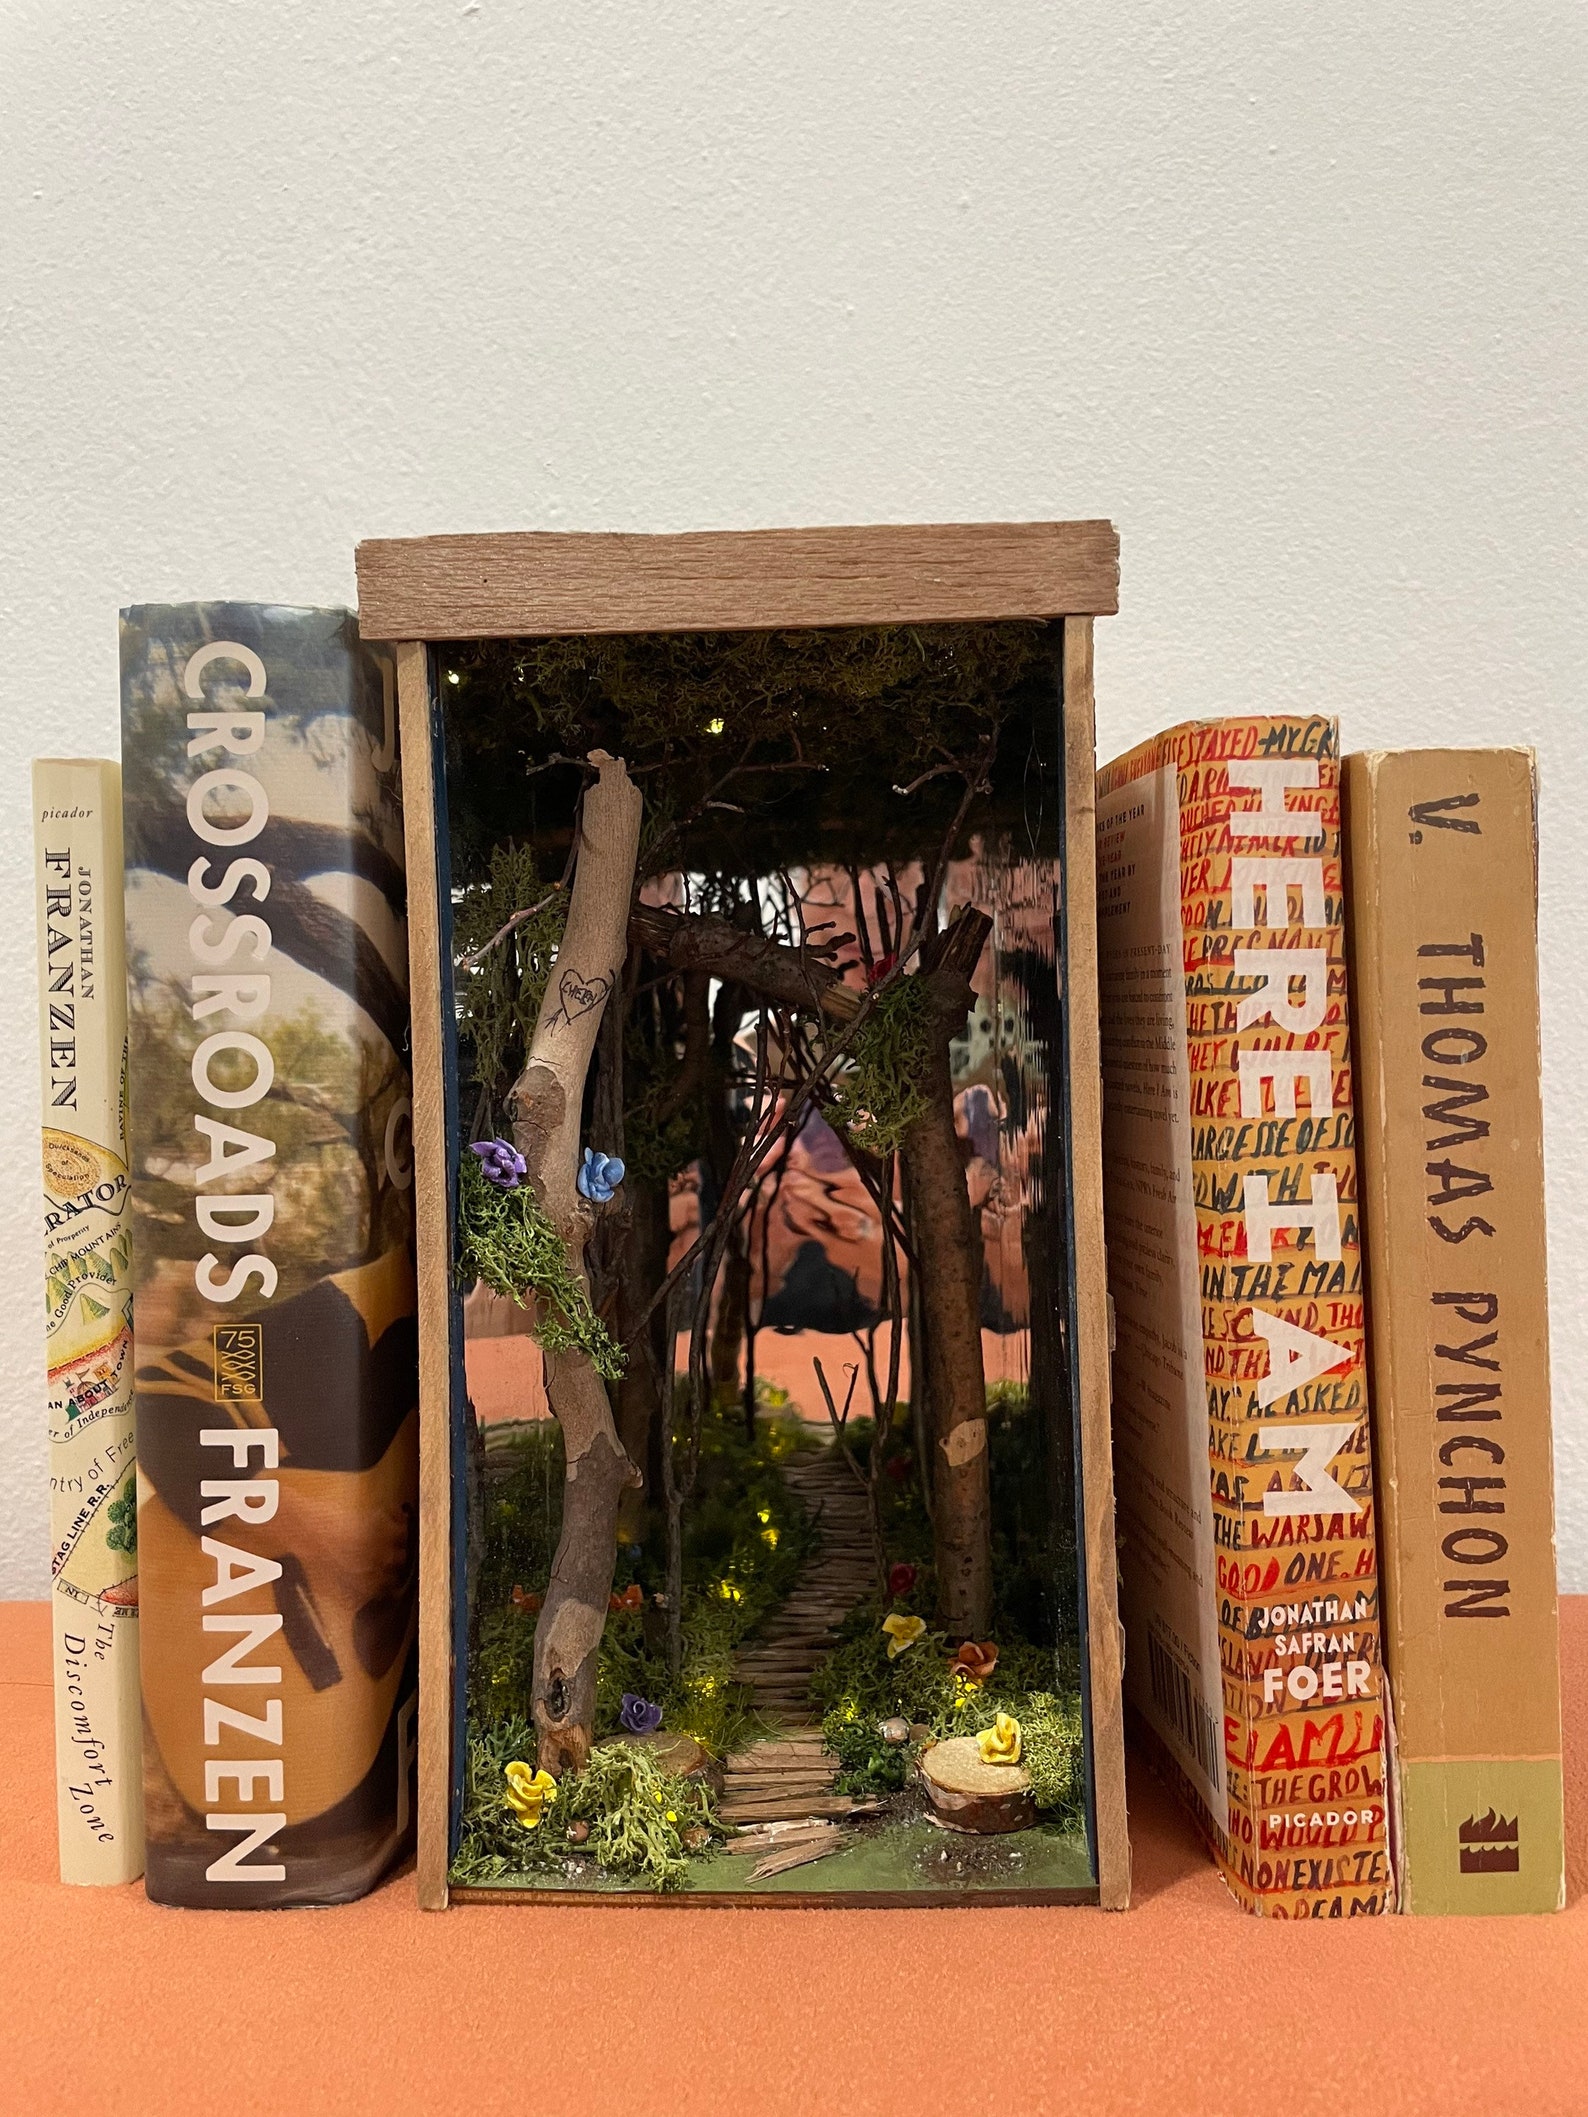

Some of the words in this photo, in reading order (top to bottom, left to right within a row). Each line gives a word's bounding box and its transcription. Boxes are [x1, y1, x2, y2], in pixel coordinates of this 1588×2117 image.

[42, 806, 94, 823] picador
[78, 865, 95, 1000] JONATHAN
[1228, 759, 1333, 1118] HERE
[45, 847, 77, 1113] FRANZEN
[184, 640, 278, 1302] CROSSROADS
[1416, 932, 1496, 1245] THOMAS
[54, 1289, 73, 1319] Good
[67, 1269, 117, 1291] Provider
[1202, 1264, 1226, 1301] IN
[1231, 1261, 1295, 1304] THE
[220, 1330, 255, 1349] 75
[68, 1378, 109, 1406] ABOUT
[110, 1340, 128, 1378] TOWN
[221, 1383, 256, 1395] FSG
[64, 1424, 74, 1439] of
[1252, 1307, 1363, 1516] AM
[49, 1475, 82, 1492] ntry
[88, 1457, 104, 1480] of
[105, 1431, 134, 1463] Free
[1430, 1291, 1511, 1619] PYNCHON
[67, 1507, 91, 1540] LINE
[1213, 1512, 1245, 1551] THE
[1217, 1554, 1281, 1593] GOOD
[1221, 1599, 1244, 1632] OF
[1258, 1598, 1367, 1629] JONATHAN
[95, 1622, 116, 1661] The
[200, 1428, 287, 1883] FRANZEN
[1274, 1631, 1355, 1656] SAFRAN
[1263, 1660, 1371, 1703] FOER
[64, 1632, 113, 1787] Discomfort
[68, 1782, 115, 1843] Zone
[1255, 1774, 1304, 1809] THE
[1269, 1809, 1374, 1829] PICADOR
